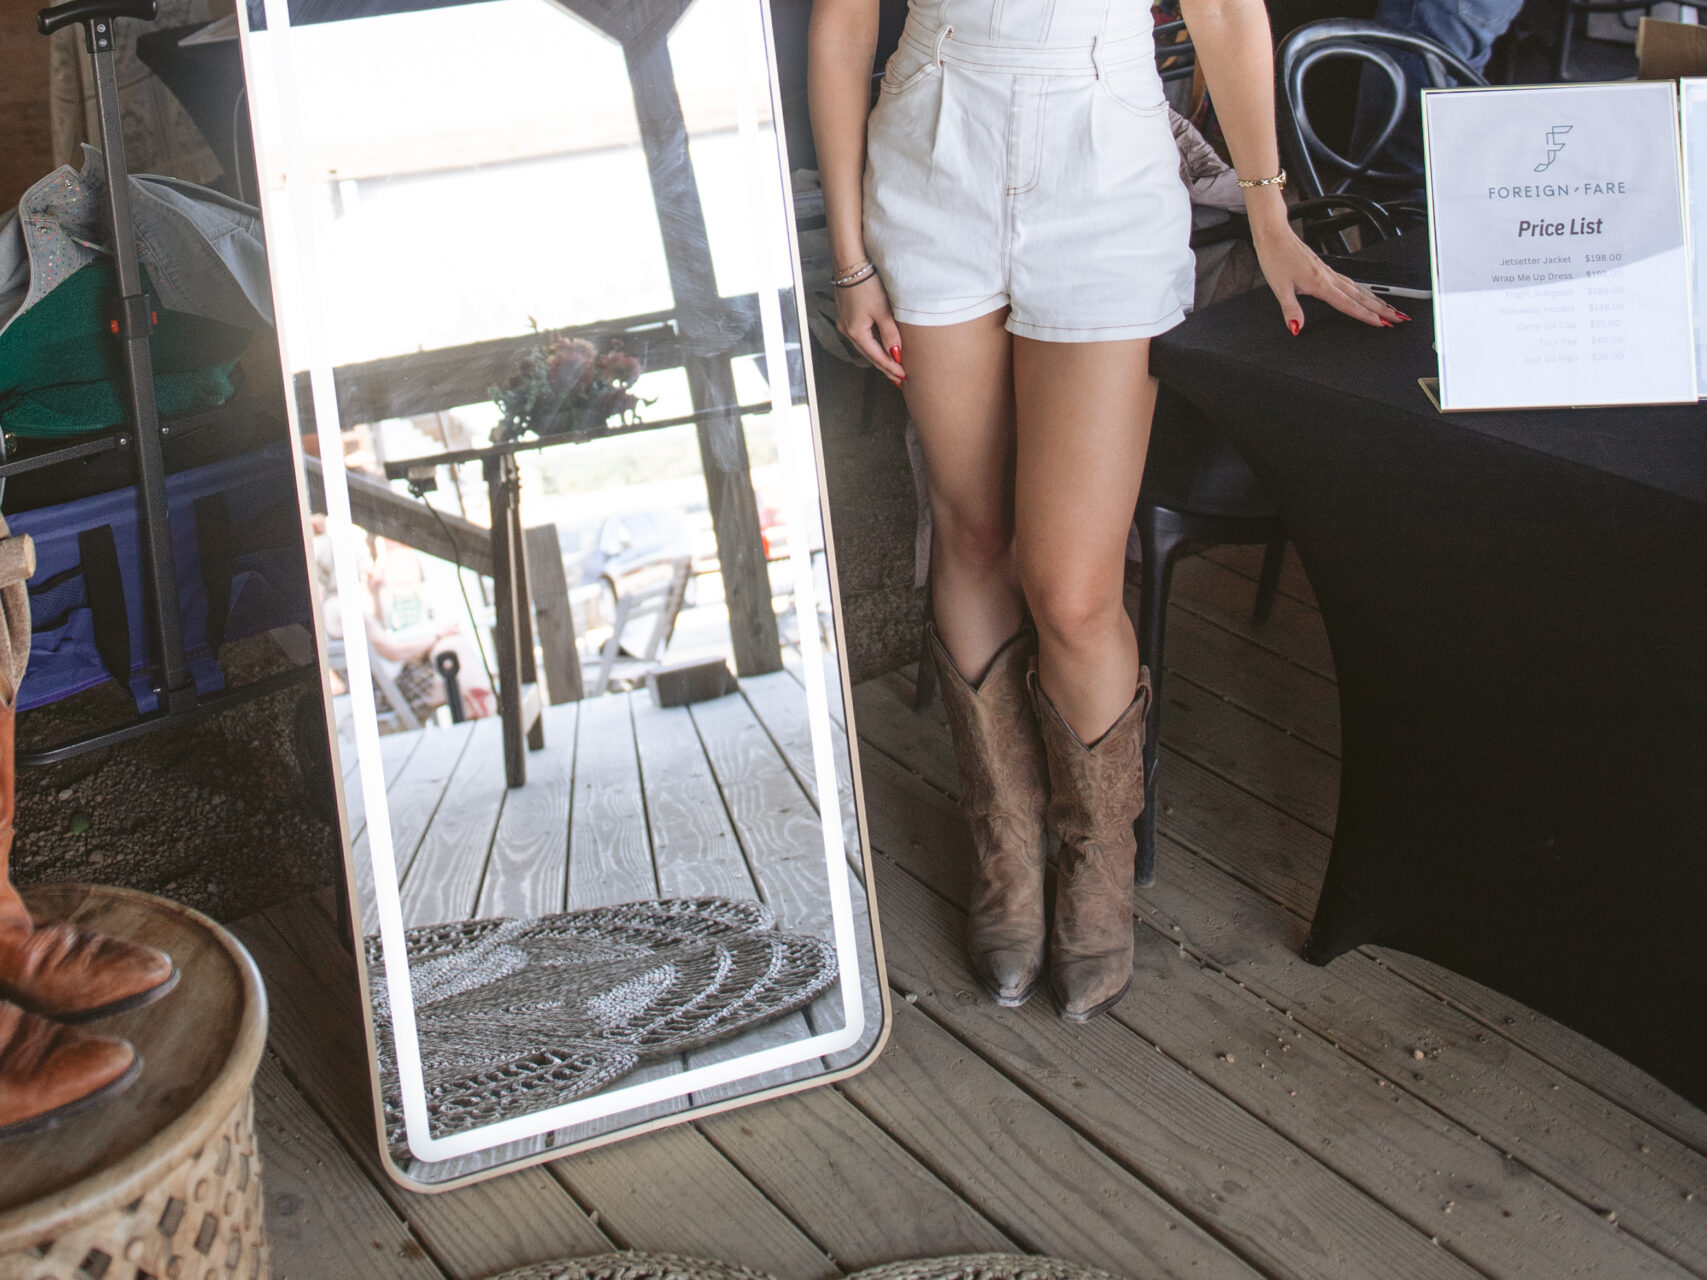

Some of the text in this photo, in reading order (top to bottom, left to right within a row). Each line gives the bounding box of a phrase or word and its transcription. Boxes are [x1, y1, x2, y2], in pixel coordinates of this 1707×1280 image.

[1488, 181, 1626, 199] FOREIGN FARE
[1518, 217, 1603, 238] Price List
[1499, 253, 1622, 266] Jetsetter Jacket $198.00
[1491, 274, 1515, 283] Wrap
[1517, 273, 1531, 282] Me
[1533, 273, 1546, 282] Up
[1548, 272, 1574, 280] Dress
